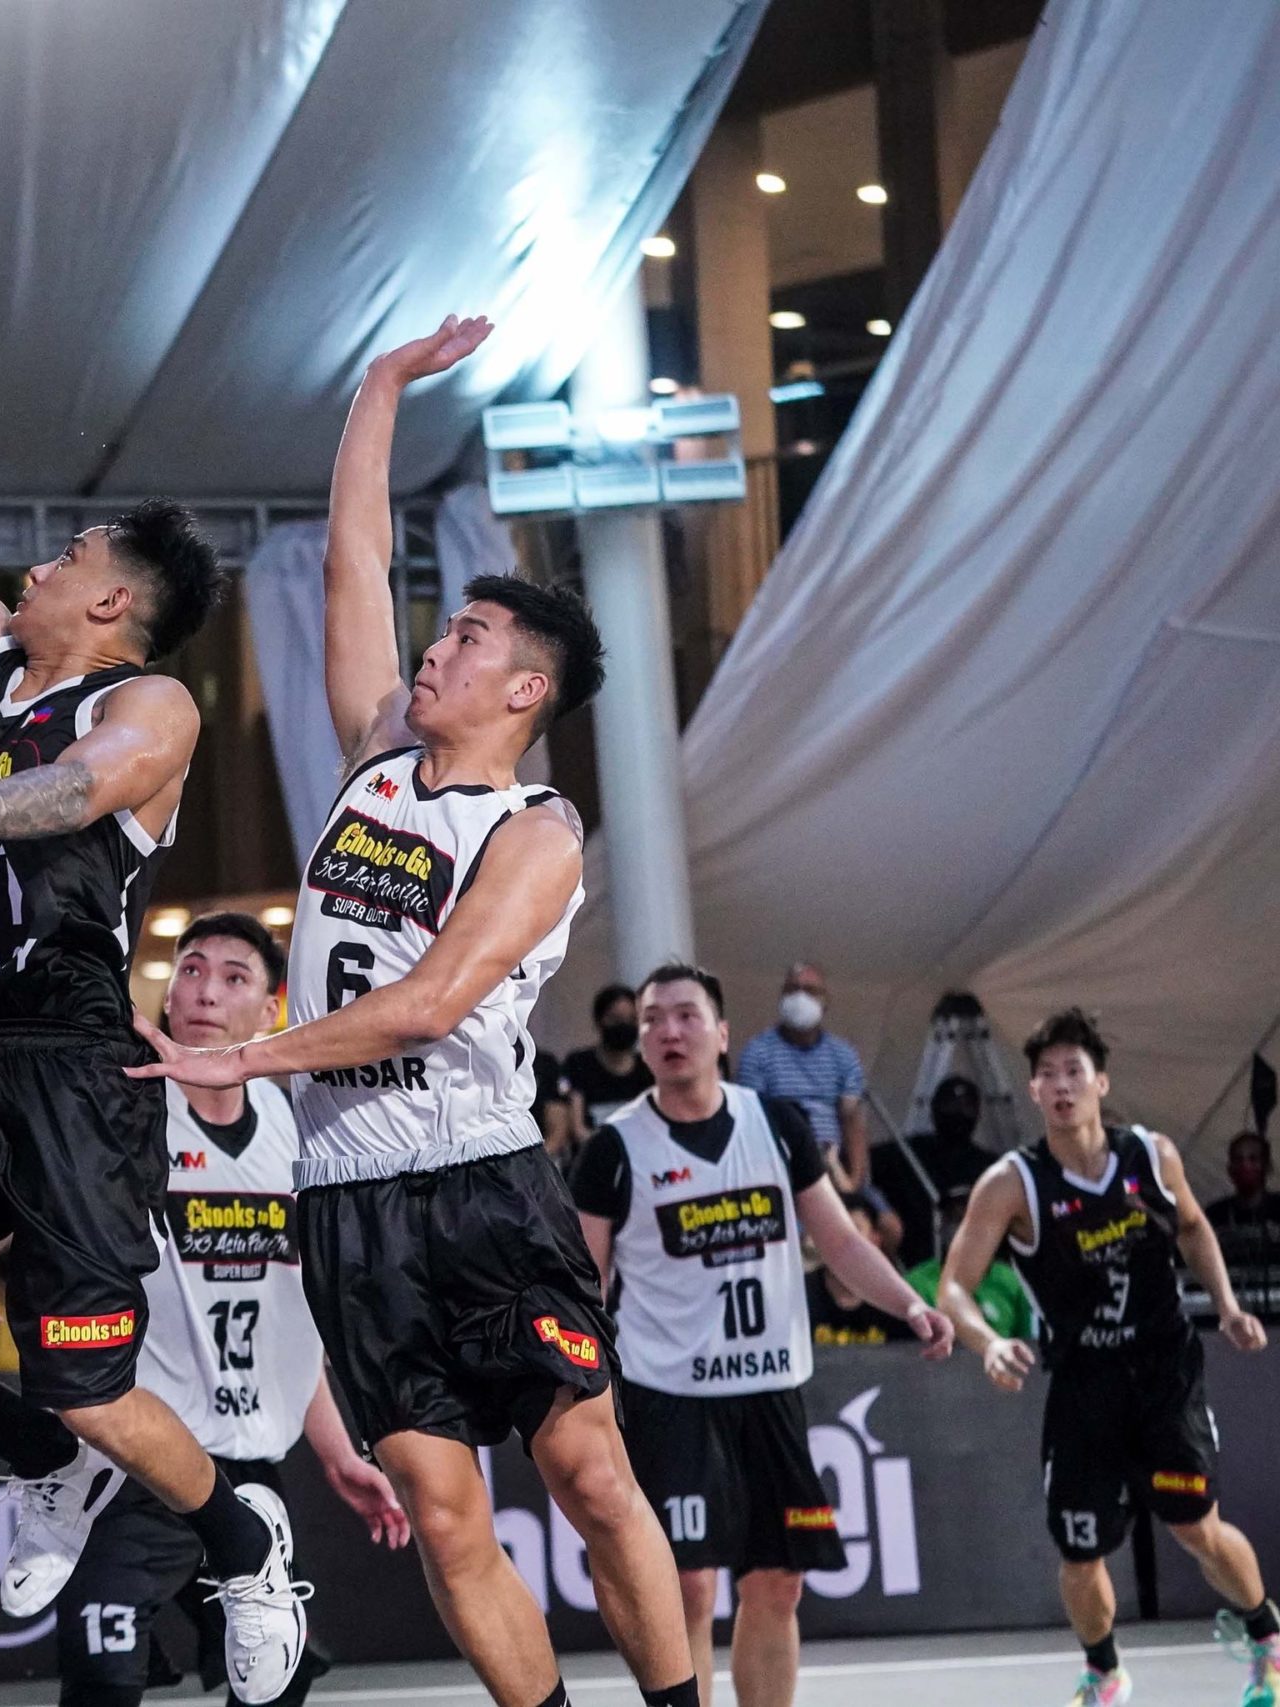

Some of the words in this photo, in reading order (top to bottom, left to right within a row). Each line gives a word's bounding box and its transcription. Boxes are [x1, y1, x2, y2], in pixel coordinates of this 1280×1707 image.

[314, 855, 349, 881] 3x3
[405, 846, 432, 881] Go
[332, 897, 367, 920] SUPER
[326, 940, 376, 1014] 6
[186, 1198, 256, 1231] Chooks
[268, 1200, 287, 1230] Go
[717, 1278, 766, 1341] 10
[46, 1319, 110, 1345] Chooks
[120, 1315, 134, 1337] Go
[206, 1299, 260, 1372] 13
[580, 1338, 596, 1361] Go
[692, 1348, 791, 1382] SANSAR
[663, 1494, 707, 1542] 10
[1060, 1509, 1098, 1549] 13
[80, 1602, 137, 1655] 13
